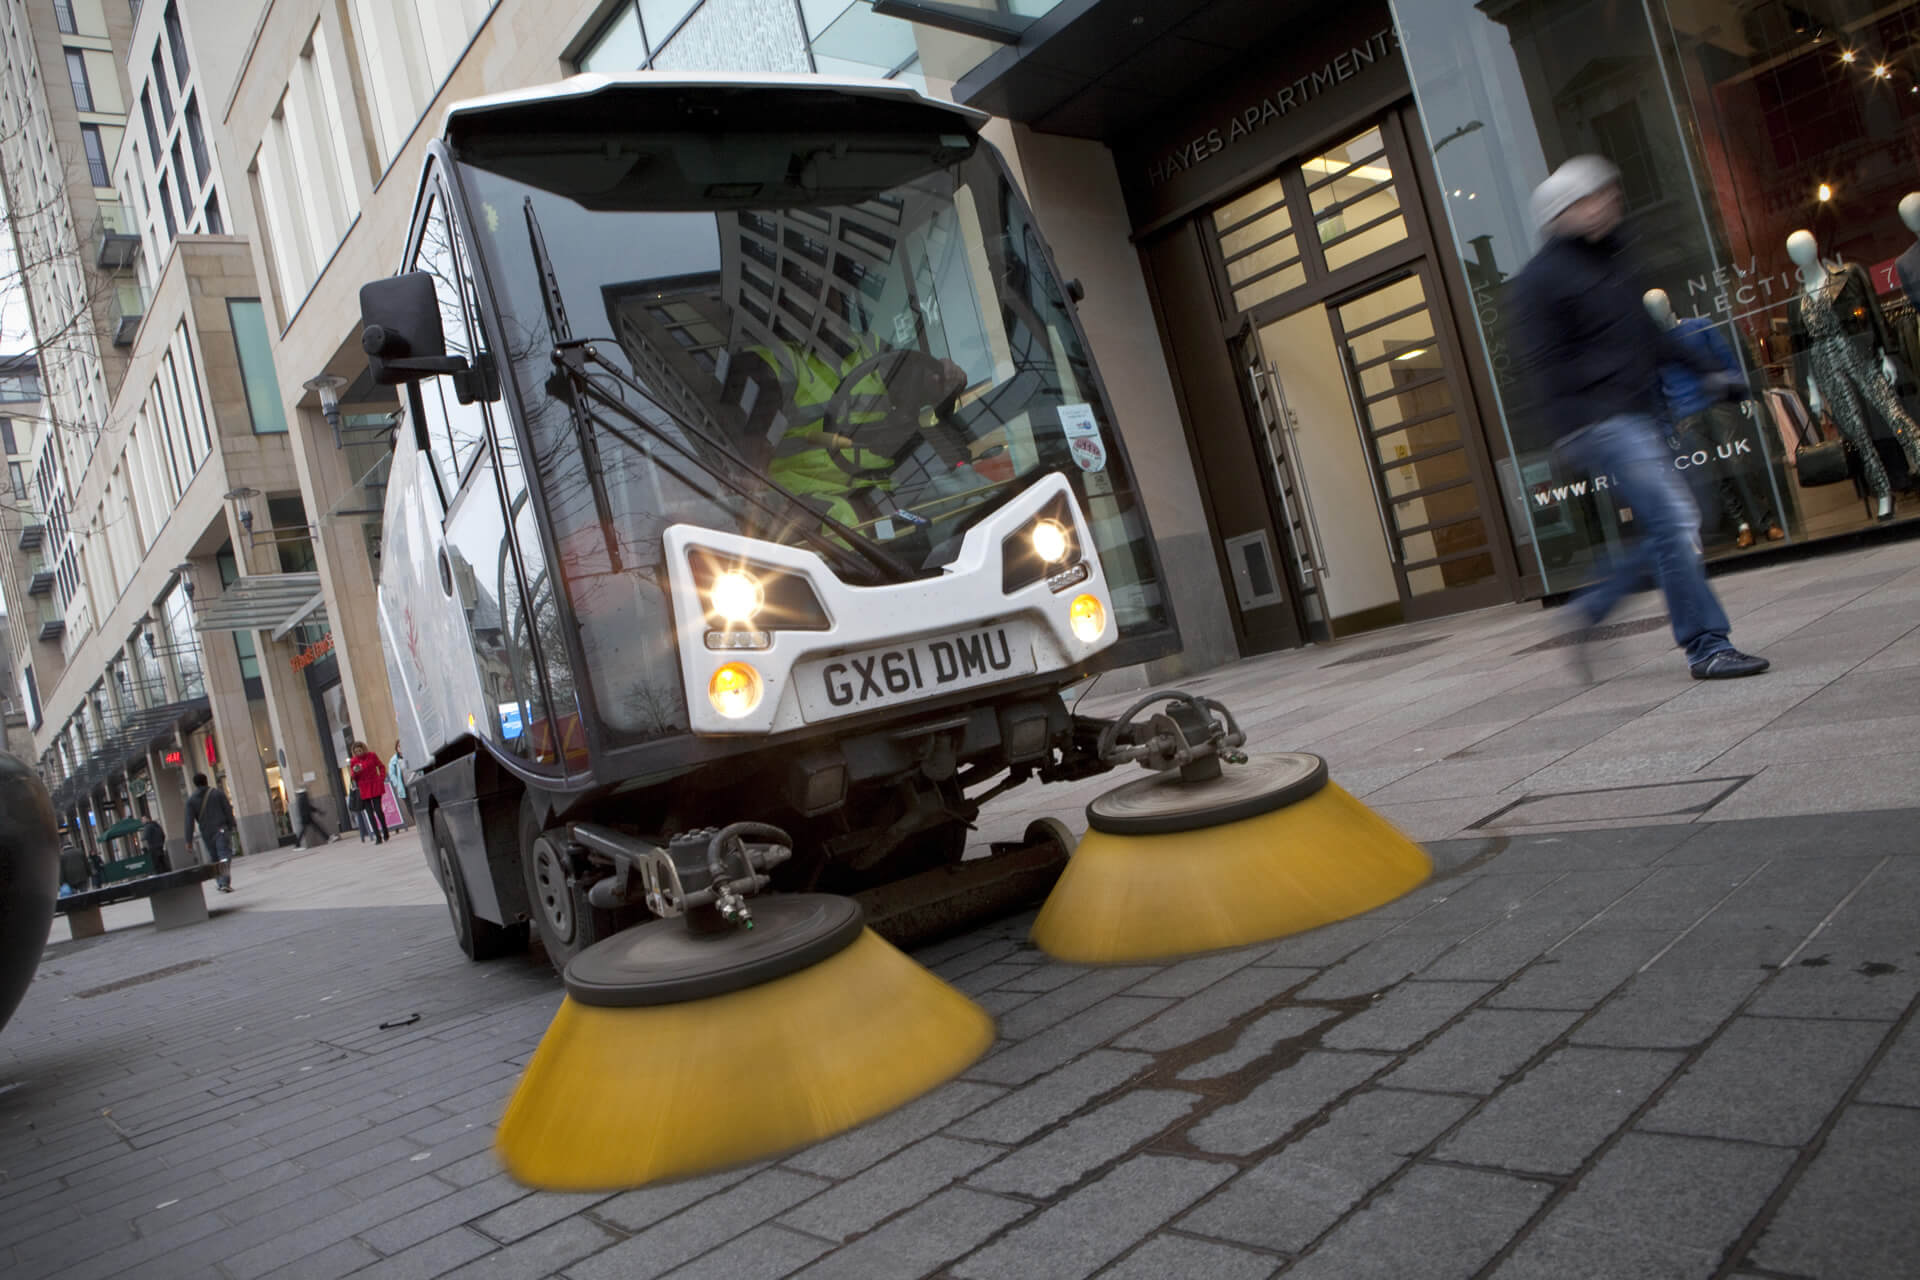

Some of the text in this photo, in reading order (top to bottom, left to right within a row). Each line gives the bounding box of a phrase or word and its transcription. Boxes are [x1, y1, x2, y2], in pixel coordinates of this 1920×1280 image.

[1148, 26, 1409, 185] HAYES APARTMENTS
[1687, 255, 1756, 298] NEW
[1692, 253, 1845, 320] LECTION
[823, 629, 1012, 707] GX61 DMU
